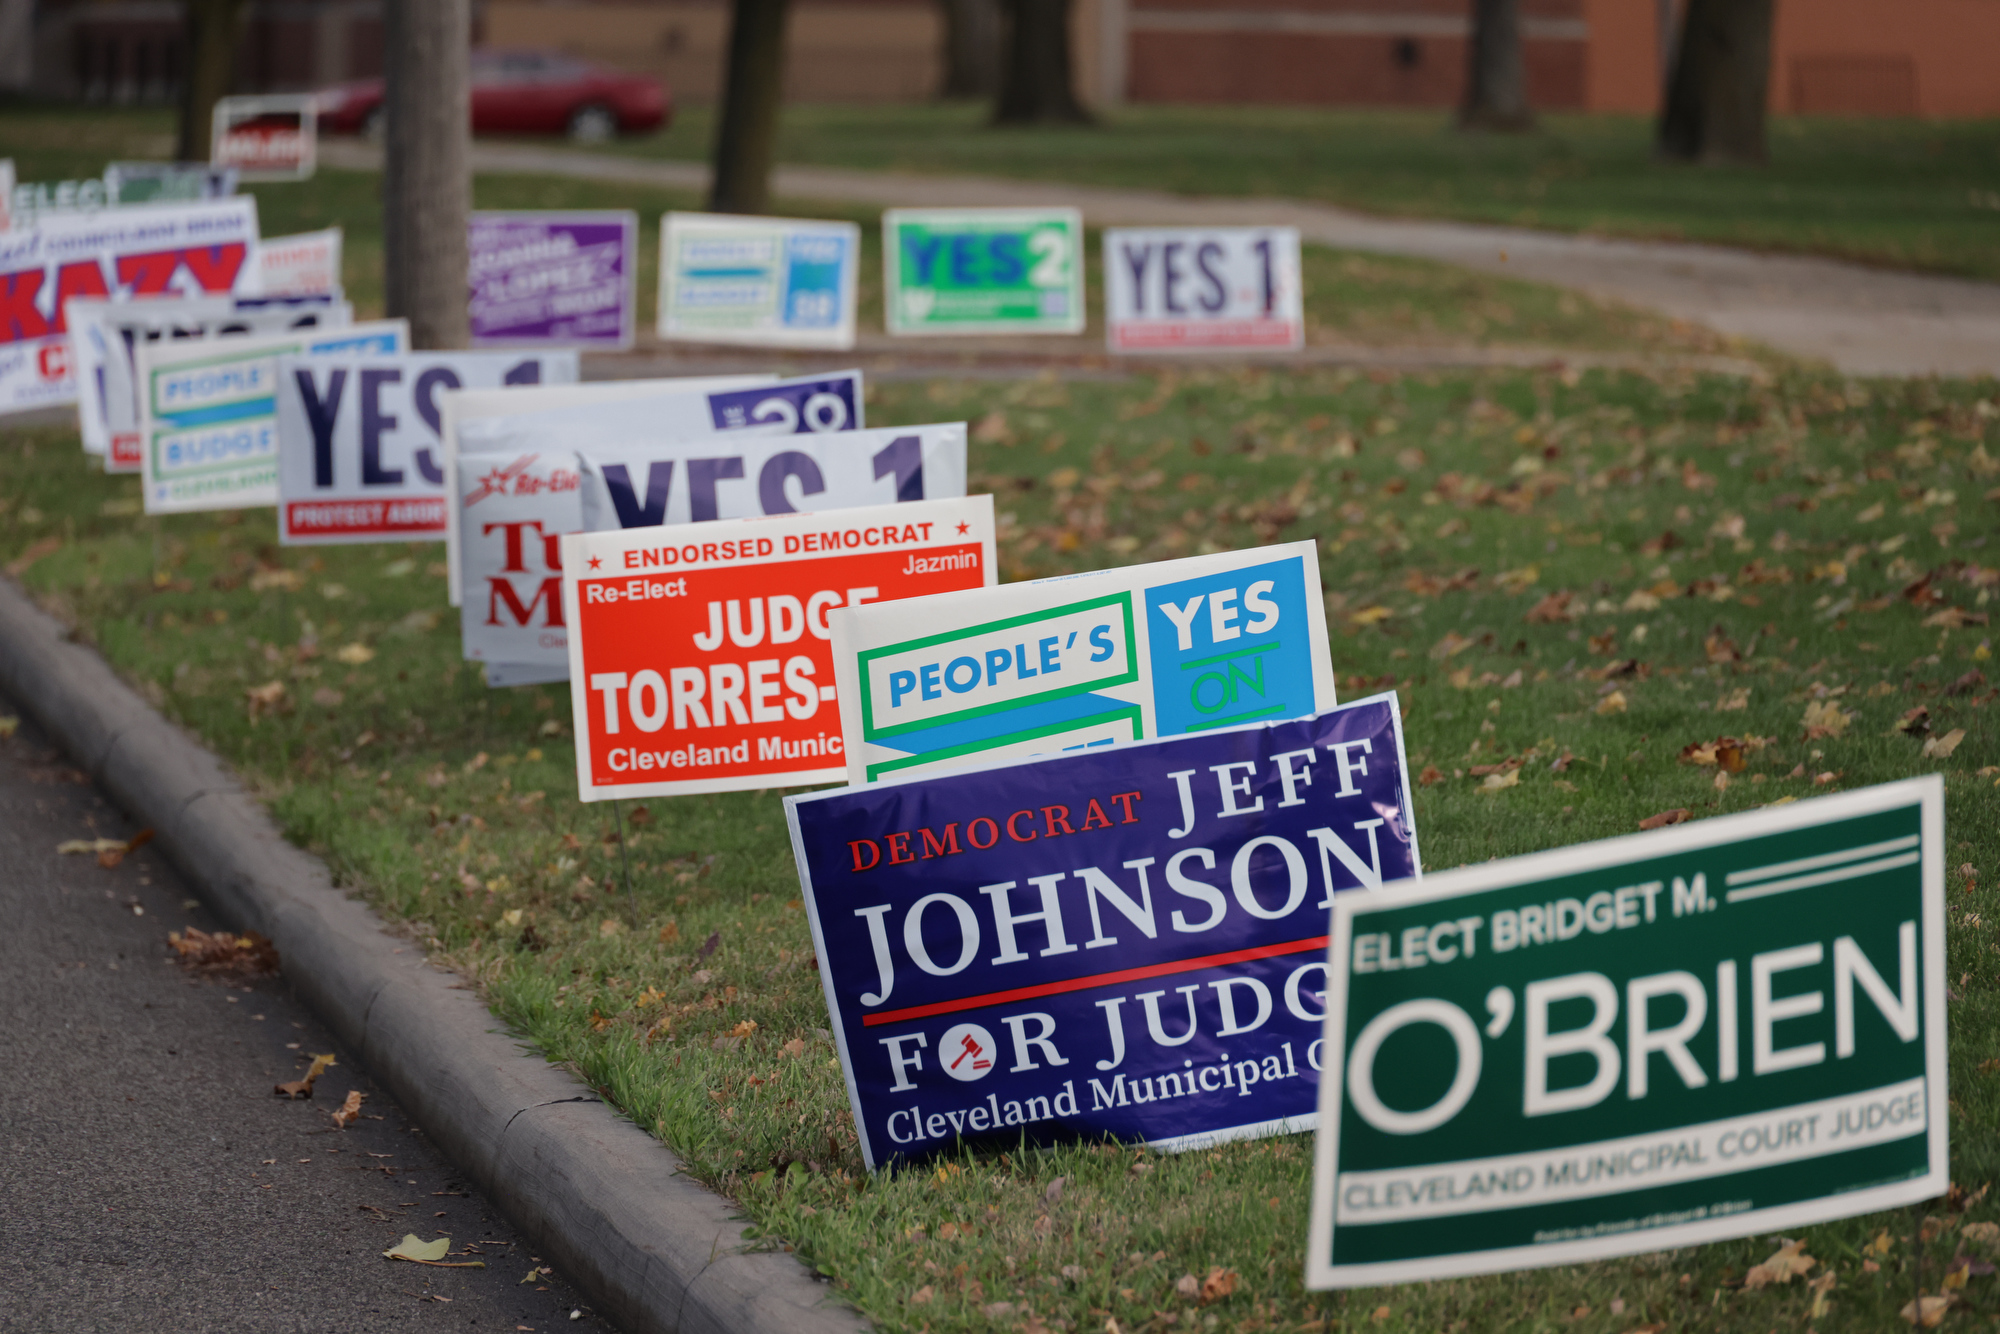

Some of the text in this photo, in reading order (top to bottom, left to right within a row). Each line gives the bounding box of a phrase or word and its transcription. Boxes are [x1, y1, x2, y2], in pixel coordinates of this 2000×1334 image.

[902, 230, 1026, 288] YES
[1027, 227, 1069, 290] 2
[1120, 237, 1277, 318] YES 1
[292, 364, 463, 488] YES
[292, 503, 383, 527] PROTECT
[623, 522, 934, 570] ENDORSED DEMOCRAT
[586, 578, 688, 604] Re-Elect
[902, 549, 977, 575] Jazmin
[1158, 580, 1281, 652] YES
[888, 624, 1115, 709] PEOPLE'S
[1190, 655, 1267, 715] ON
[607, 739, 751, 772] Cleveland
[847, 738, 1374, 873] DEMOCRAT JEFF
[853, 817, 1386, 1007] JOHNSON
[1352, 870, 1719, 976] ELECT BRIDGET M.
[1346, 919, 1921, 1137] O'BRIEN
[885, 1080, 1081, 1145] Cleveland
[1090, 1041, 1301, 1114] Municipal
[1343, 1090, 1924, 1213] CLEVELAND MUNICIPAL COURT JUDGE
